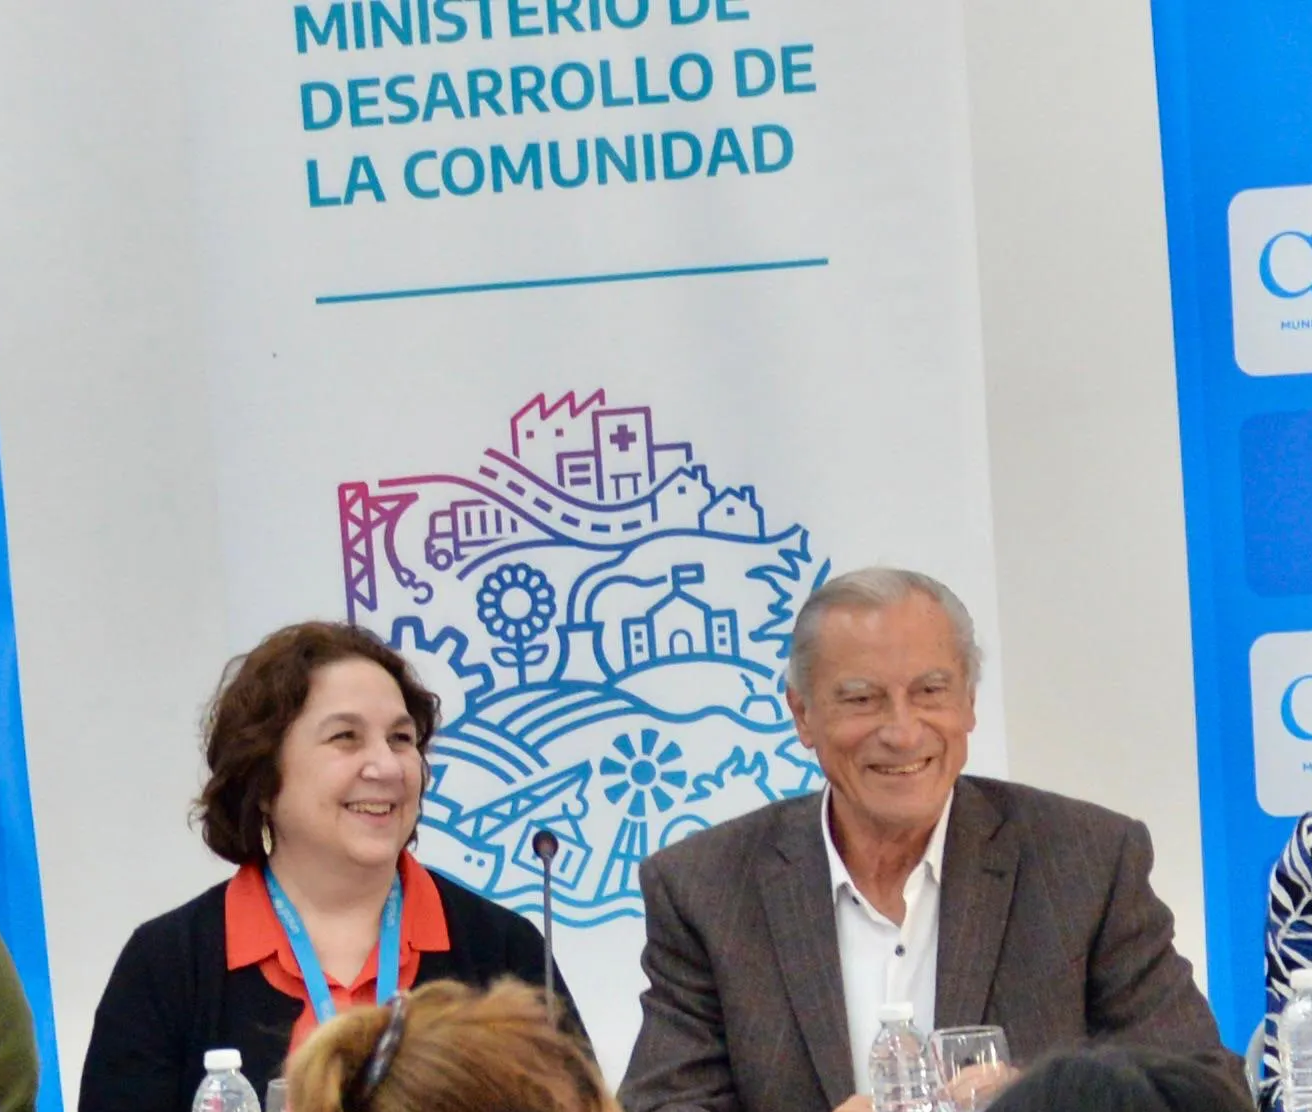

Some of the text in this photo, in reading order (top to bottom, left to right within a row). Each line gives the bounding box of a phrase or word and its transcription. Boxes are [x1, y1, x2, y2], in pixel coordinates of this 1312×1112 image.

[293, 0, 650, 54] MINISTERIO
[300, 43, 817, 131] DESARROLLO DE
[306, 123, 794, 208] LA COMUNIDAD
